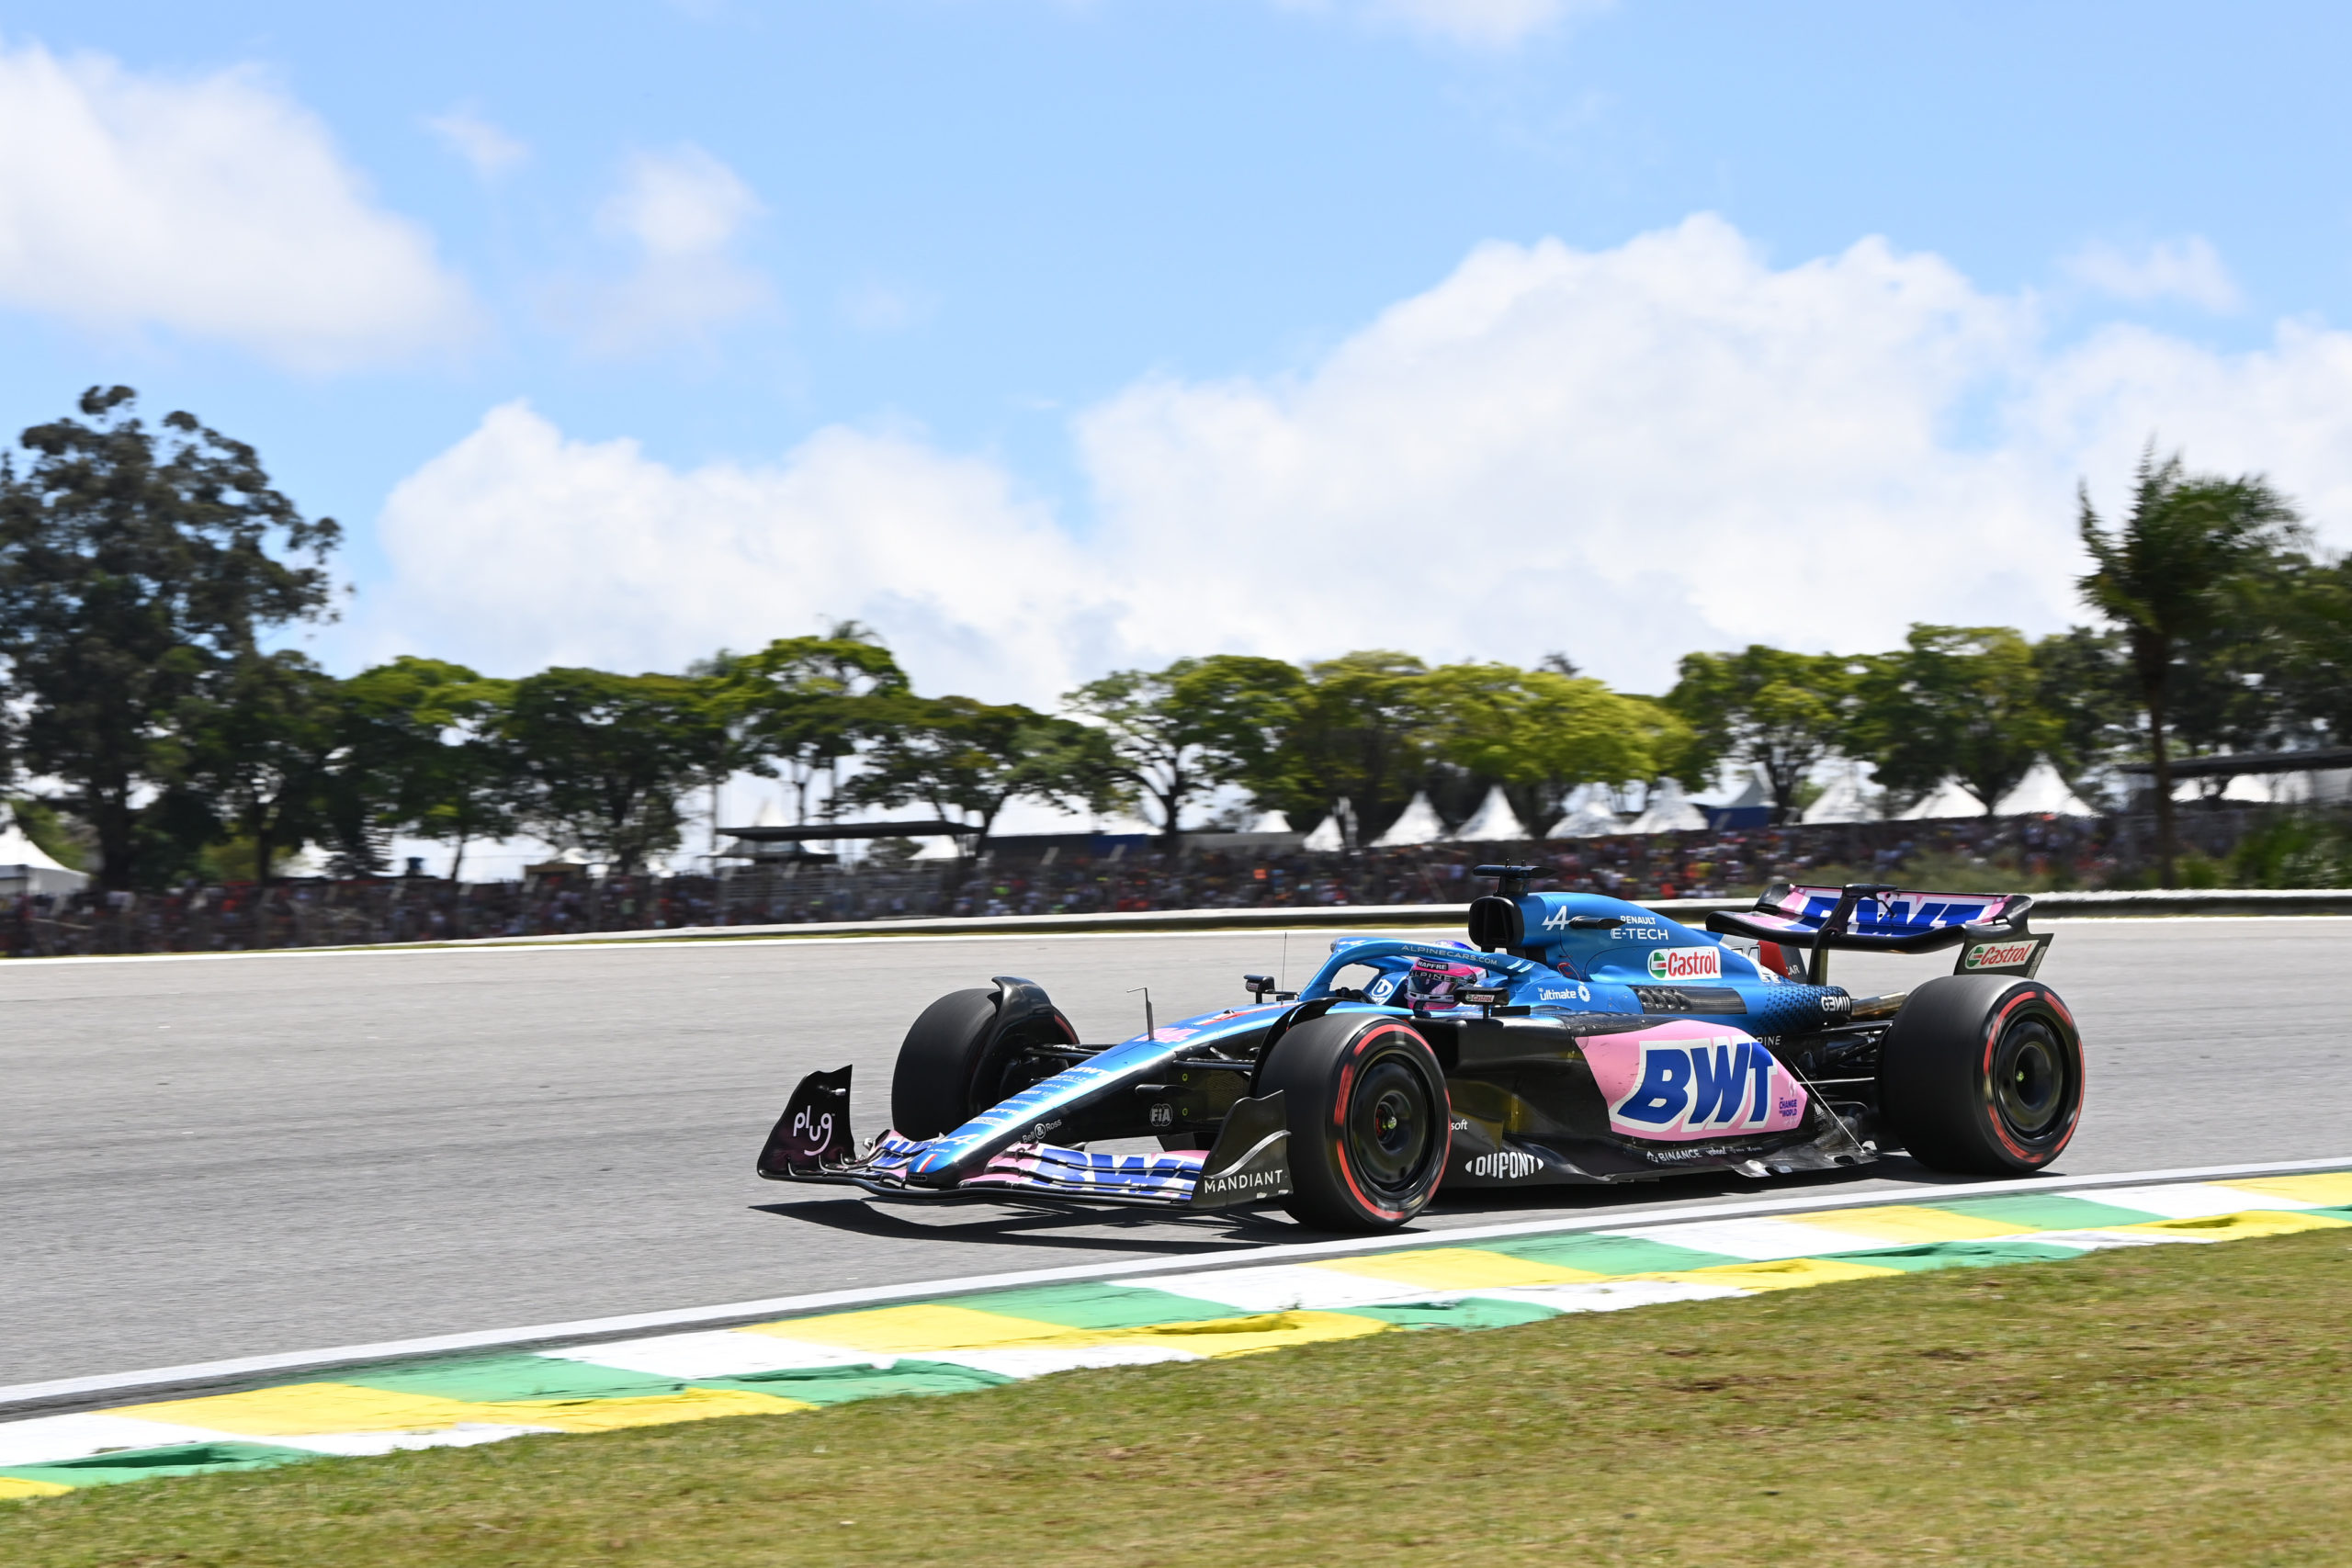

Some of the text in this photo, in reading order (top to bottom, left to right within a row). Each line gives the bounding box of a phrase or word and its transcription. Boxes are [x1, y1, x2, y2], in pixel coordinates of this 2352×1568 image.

[1621, 915, 1657, 925] RENAULT
[1611, 928, 1669, 941] E-TECH
[1401, 944, 1498, 965] ALPINECARS.COM
[1668, 951, 1718, 977] Castrol
[1981, 943, 2032, 964] Castrol
[1418, 960, 1448, 971] MAPFRE
[1472, 994, 1493, 1002] Castrol
[1540, 988, 1577, 1001] ultimate
[1617, 1042, 1774, 1124] BWT
[793, 1105, 832, 1156] plug
[1022, 1131, 1035, 1144] Bell
[1046, 1119, 1062, 1132] Ross
[1475, 1152, 1536, 1179] DUPONT
[1657, 1149, 1703, 1162] BINANCE
[1031, 1147, 1203, 1198] BWT
[1204, 1169, 1284, 1194] MANDIANT
